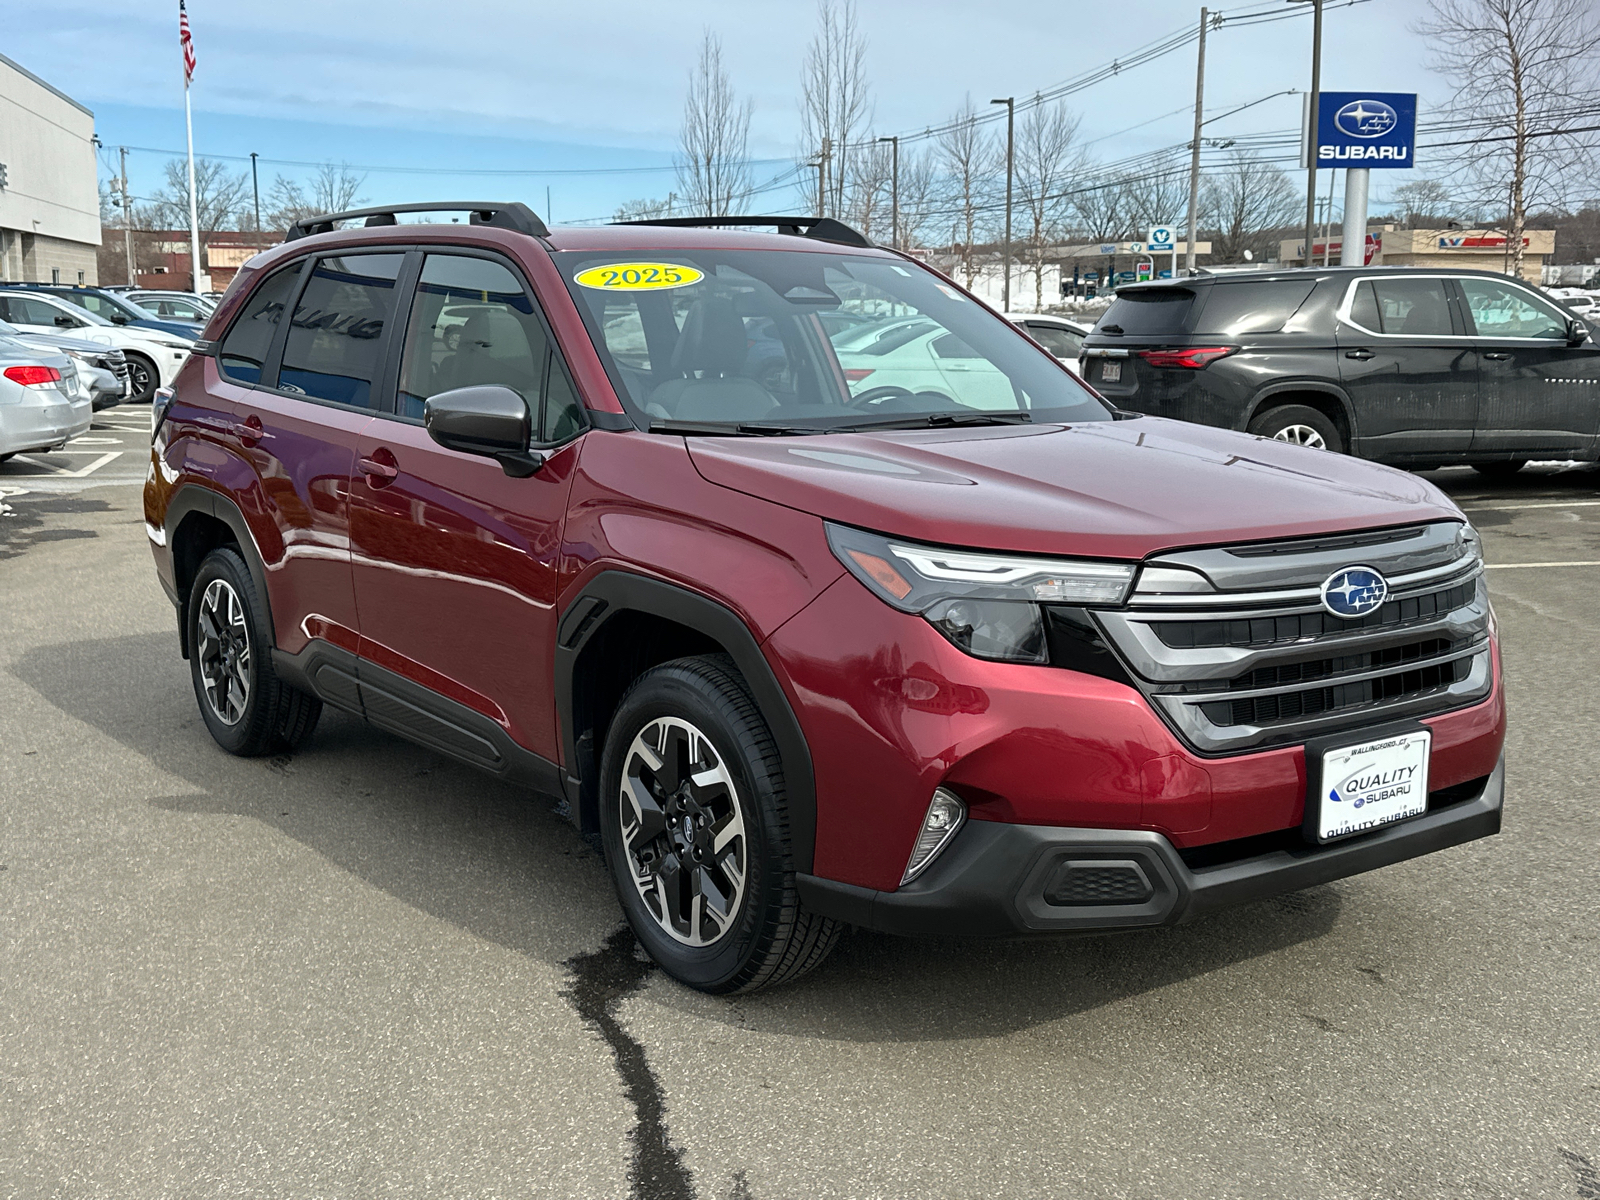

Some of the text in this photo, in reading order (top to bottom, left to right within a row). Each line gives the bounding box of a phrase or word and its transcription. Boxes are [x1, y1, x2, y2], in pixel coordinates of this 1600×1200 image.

[1319, 145, 1407, 160] SUBARU
[601, 268, 682, 286] 2025
[1346, 764, 1418, 793] QUALITY
[1366, 785, 1411, 804] SUBARU
[1327, 807, 1423, 838] QUALITY SUBARU
